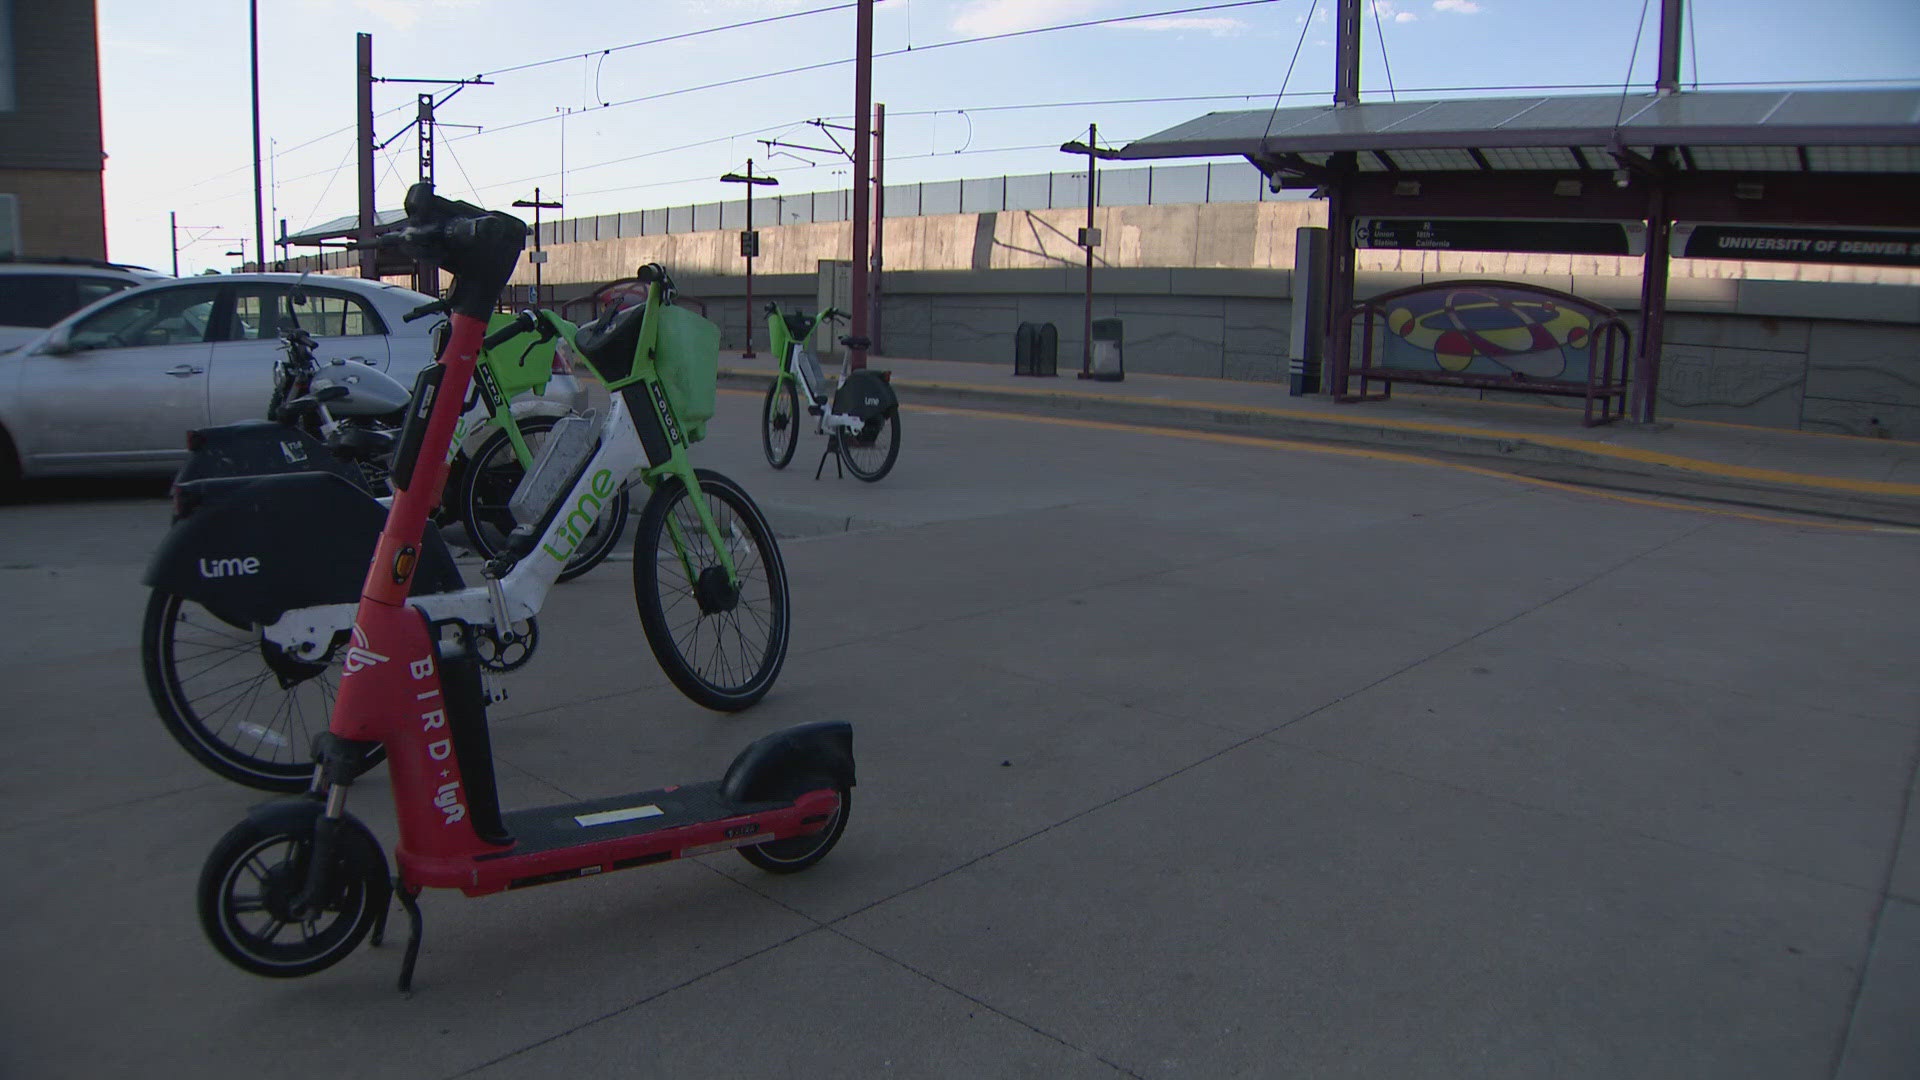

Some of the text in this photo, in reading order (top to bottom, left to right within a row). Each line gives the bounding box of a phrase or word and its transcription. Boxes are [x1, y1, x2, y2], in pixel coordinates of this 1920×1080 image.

[1374, 239, 1398, 247] Station
[1416, 239, 1451, 247] California
[1718, 236, 1812, 251] UNIVERSITY
[1814, 239, 1837, 252] OF
[1839, 240, 1908, 255] DENVER
[654, 386, 678, 441] 1968
[543, 469, 615, 562] Lime
[199, 556, 261, 578] Lime
[409, 654, 452, 761] BIRD
[434, 780, 466, 825] lyft
